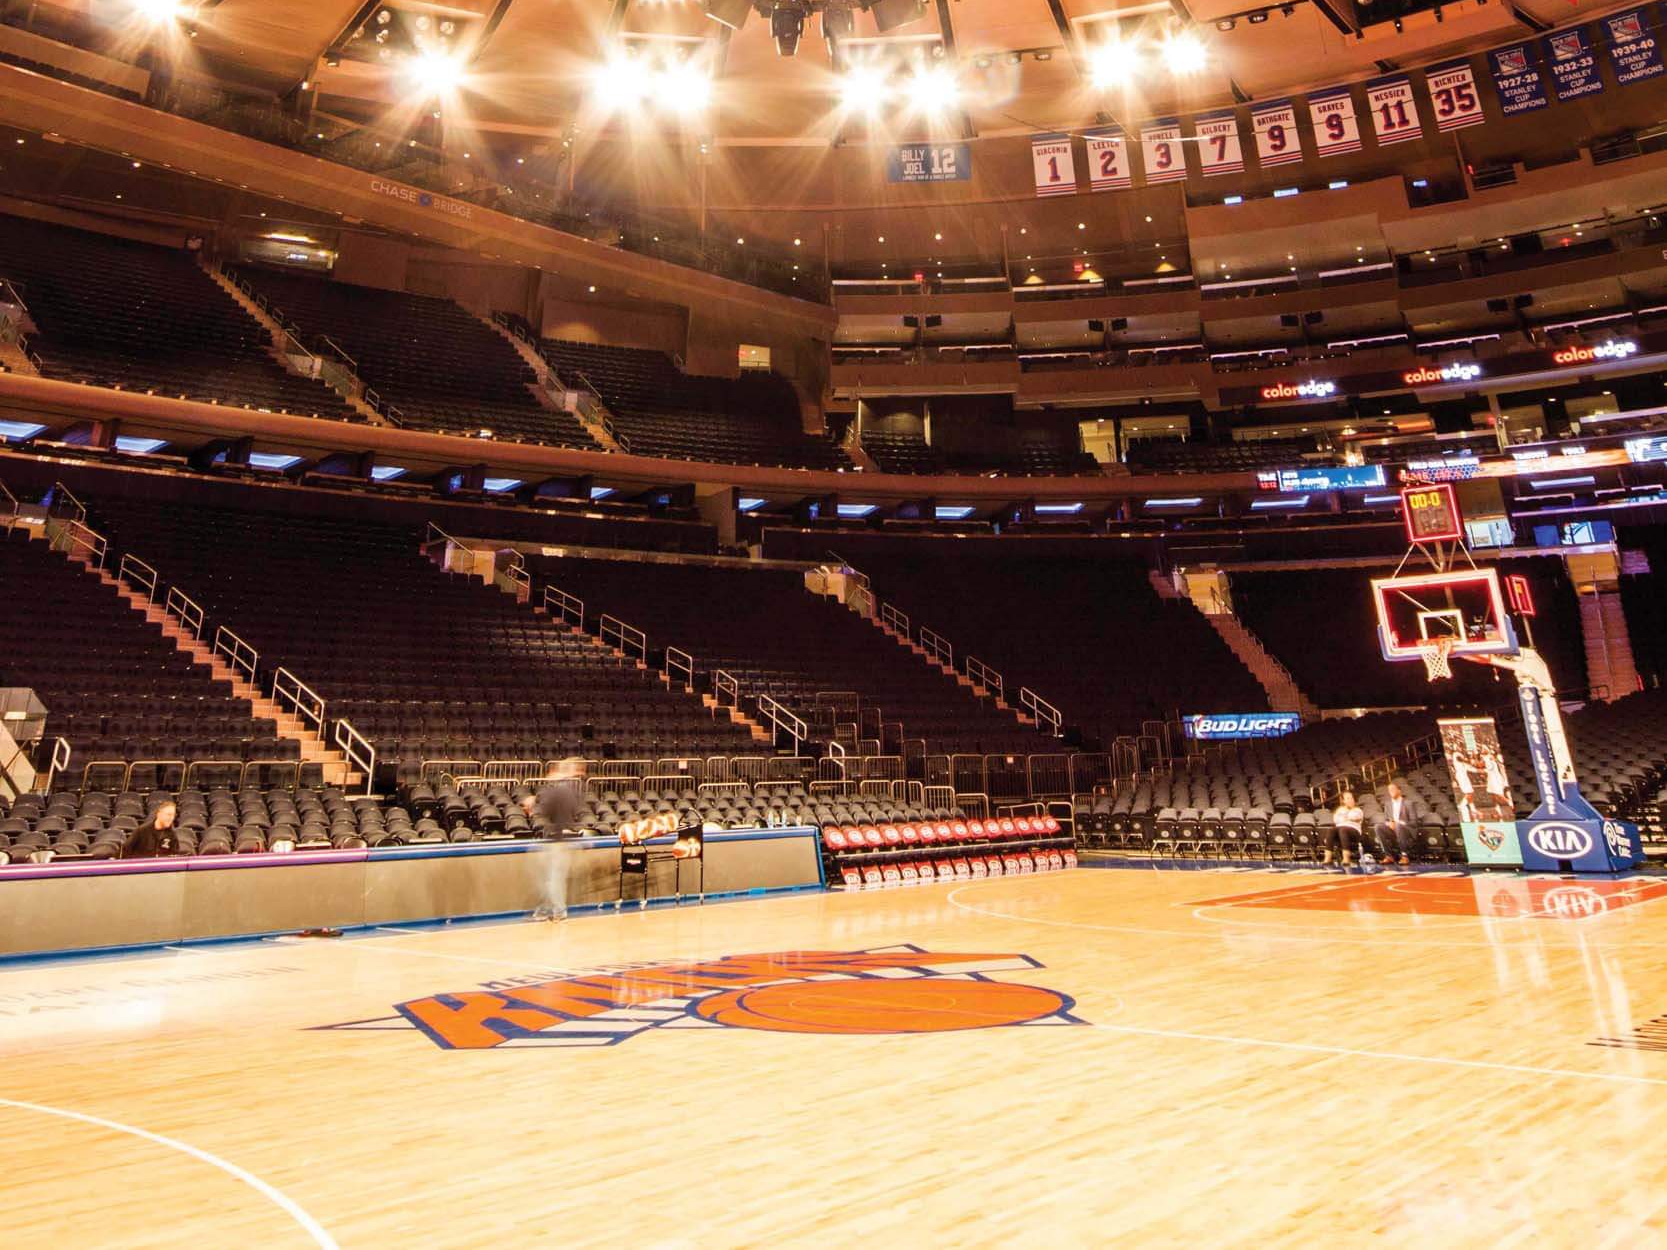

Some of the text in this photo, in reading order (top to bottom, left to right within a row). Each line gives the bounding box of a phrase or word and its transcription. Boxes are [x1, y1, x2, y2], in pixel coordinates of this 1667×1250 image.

[1611, 39, 1656, 58] 1939-40
[1552, 56, 1594, 75] 1932-33
[1619, 51, 1653, 66] STANLEY
[1630, 61, 1647, 71] CUP
[1434, 73, 1467, 88] RICHTER
[1498, 72, 1540, 90] 1927-28
[1559, 69, 1592, 83] STANLEY
[1618, 64, 1665, 83] CHAMPIONS
[1504, 84, 1537, 98] STANLEY
[1558, 81, 1603, 99] CHAMPIONS
[1569, 78, 1586, 89] CUP
[1434, 82, 1476, 117] 35
[1503, 97, 1547, 113] CHAMPIONS
[1515, 94, 1531, 103] CUP
[1379, 100, 1410, 131] 11
[1325, 113, 1345, 141] 9
[1210, 135, 1226, 161] 7
[1267, 125, 1287, 152] 9
[902, 149, 925, 161] BILLY
[931, 148, 956, 174] 12
[1099, 150, 1118, 177] 2
[1155, 142, 1172, 169] 3
[904, 161, 925, 174] JOEL
[1048, 156, 1061, 182] 1
[370, 180, 472, 219] CHASE BRIDGE
[1554, 339, 1637, 364] coloredge
[1405, 363, 1480, 385] coloredge
[1262, 380, 1334, 400] coloredge
[1199, 718, 1293, 733] BUD LIGHT
[1526, 702, 1542, 745] FOOT
[1535, 750, 1557, 815] LOCKER
[1538, 829, 1582, 851] KIA
